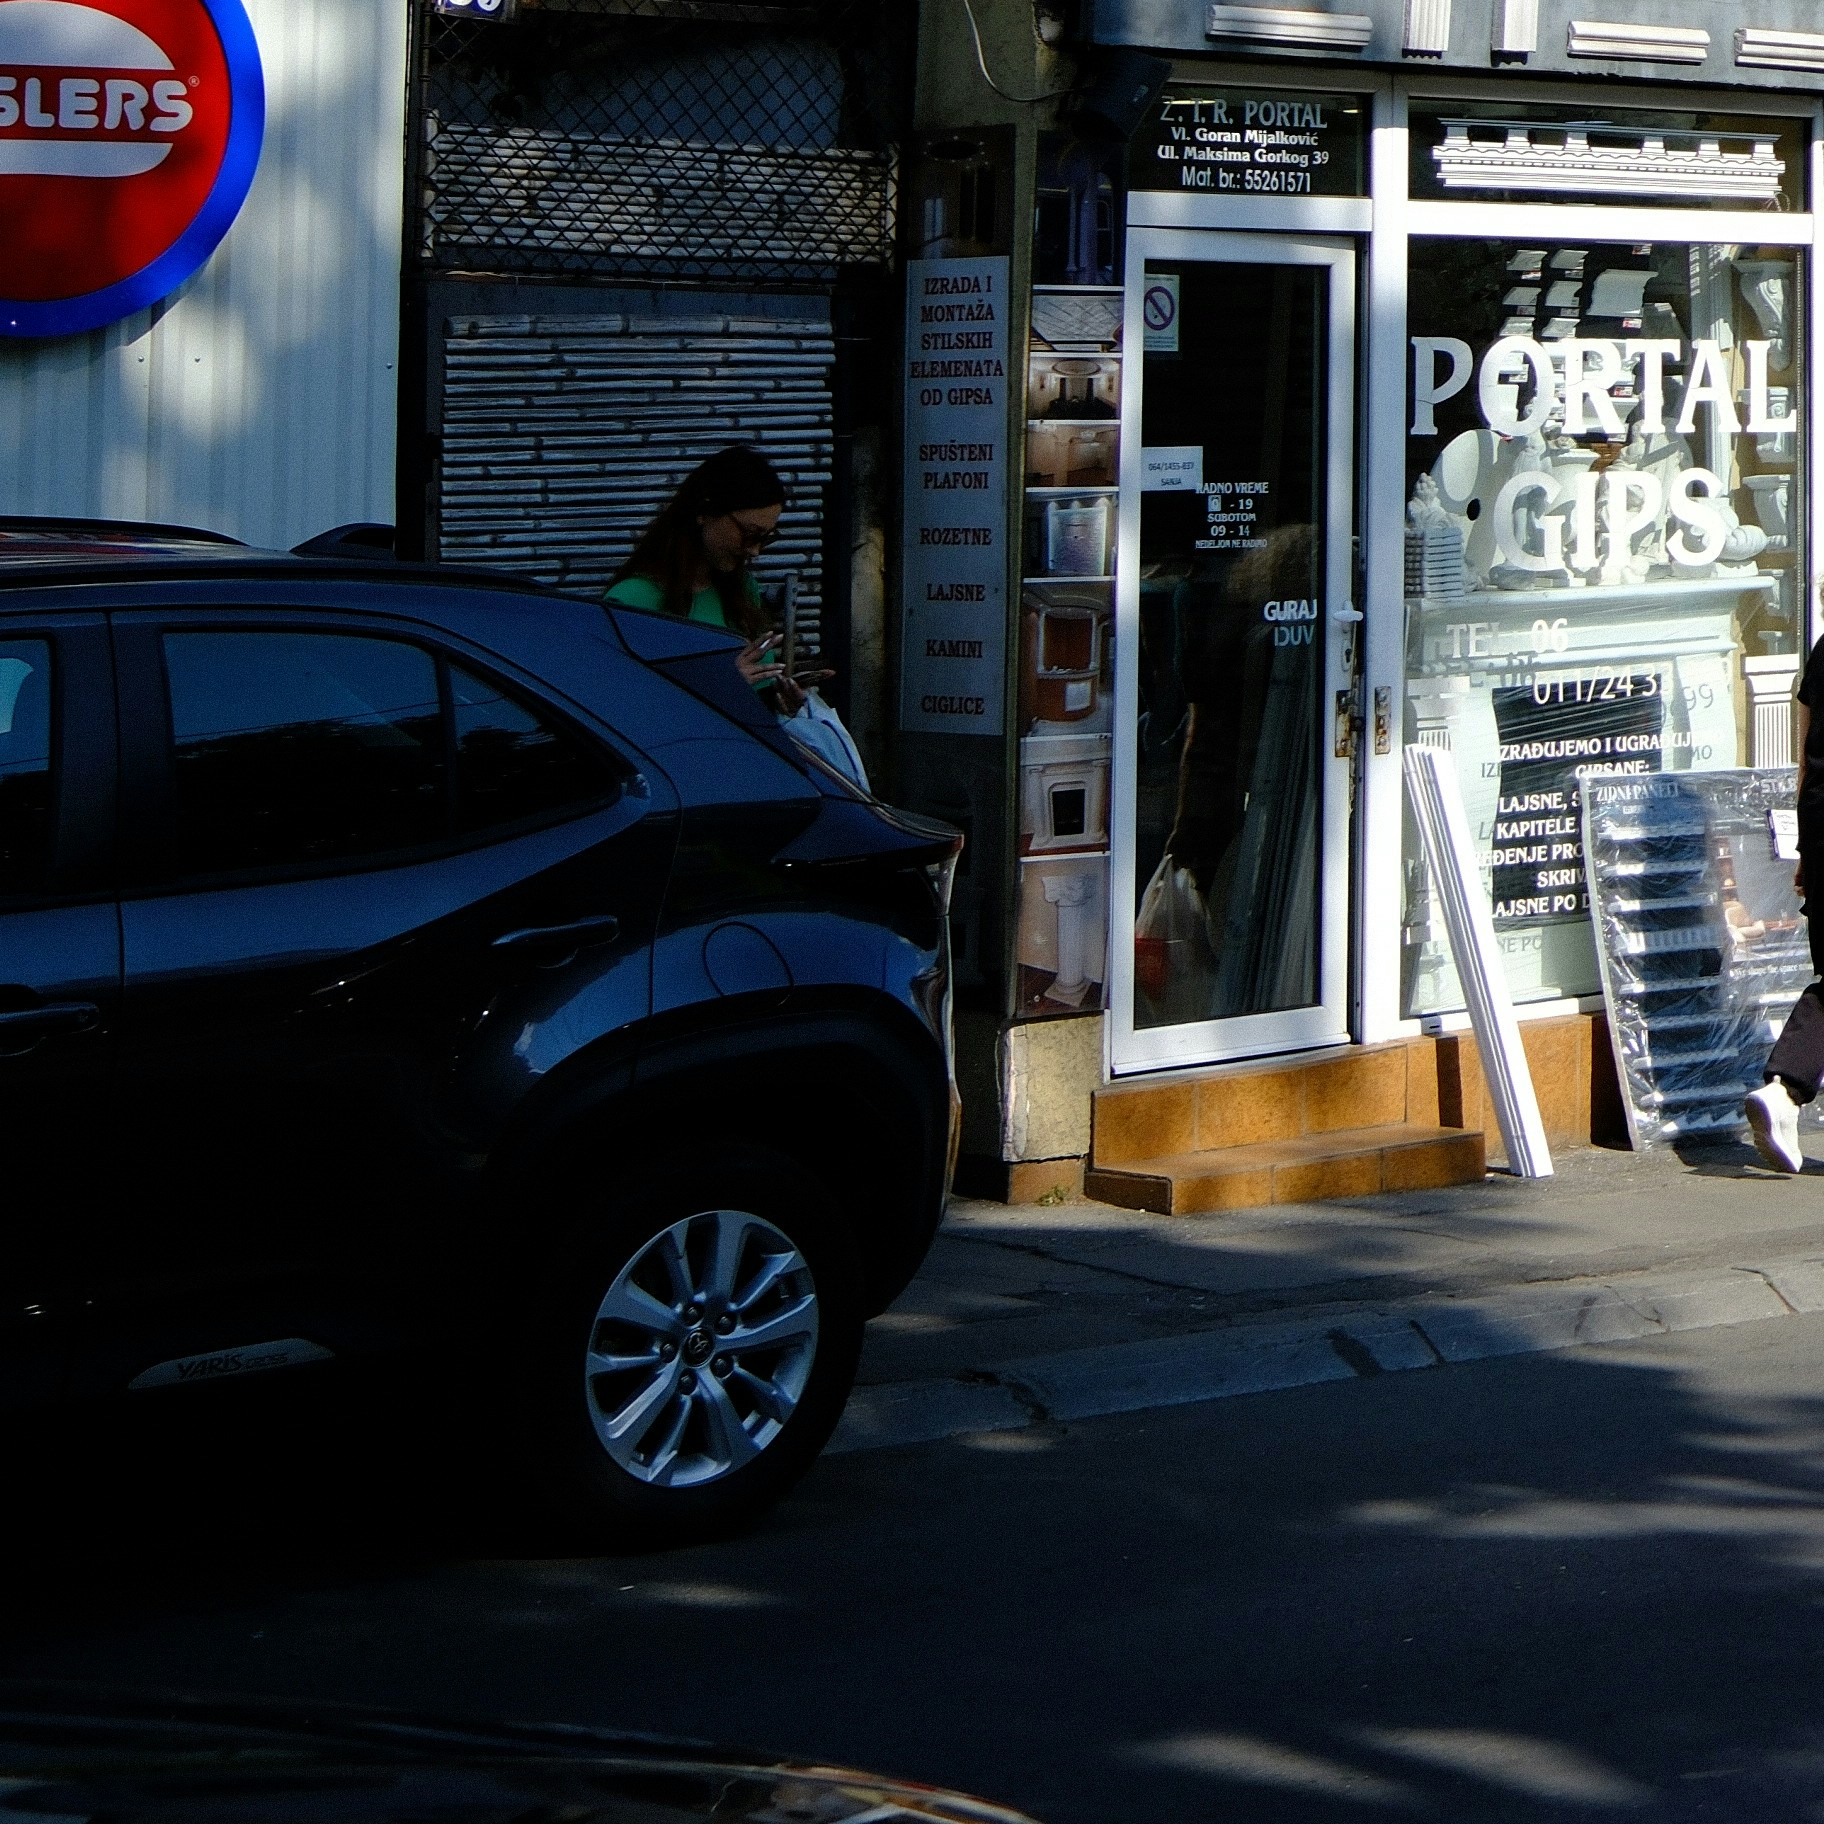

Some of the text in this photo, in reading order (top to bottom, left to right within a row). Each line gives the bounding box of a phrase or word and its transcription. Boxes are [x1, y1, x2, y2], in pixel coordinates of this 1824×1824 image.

[1244, 100, 1328, 128] PORTAL
[1195, 128, 1241, 143] Goran
[1244, 130, 1319, 147] Mijalković
[1183, 147, 1251, 162] Maksima
[1254, 148, 1309, 167] Gorkog
[1312, 151, 1330, 165] 39
[1182, 166, 1215, 187] Mat.
[1244, 169, 1311, 193] 55261571
[925, 276, 992, 295] IZRADA I
[920, 298, 995, 323] MONTAŽA
[921, 332, 993, 350] STILSKIH
[910, 359, 1004, 379] ELEMENATA
[920, 387, 993, 406] OD GIPSA
[1410, 336, 1797, 437] PORTAL
[919, 439, 994, 461] SPUŠTENI
[923, 471, 989, 490] PLAFONI
[1234, 482, 1269, 494] VREME
[1238, 498, 1254, 510] 19
[1207, 513, 1257, 522] SUBOTOM
[1494, 467, 1727, 572] GIPS
[919, 527, 992, 546] ROZETNE
[1210, 525, 1227, 537] 09
[1238, 525, 1250, 537] 14
[926, 583, 986, 602] LAJSNE
[1264, 599, 1318, 621] GURAJ
[925, 639, 983, 658] KAMINI
[921, 695, 985, 715] CIGLICE
[1495, 736, 1601, 762] ZRAĐUJEMO
[1499, 792, 1568, 814] LAJSNE,
[1492, 896, 1550, 919] AJSNE
[177, 1353, 244, 1380] YARIS
